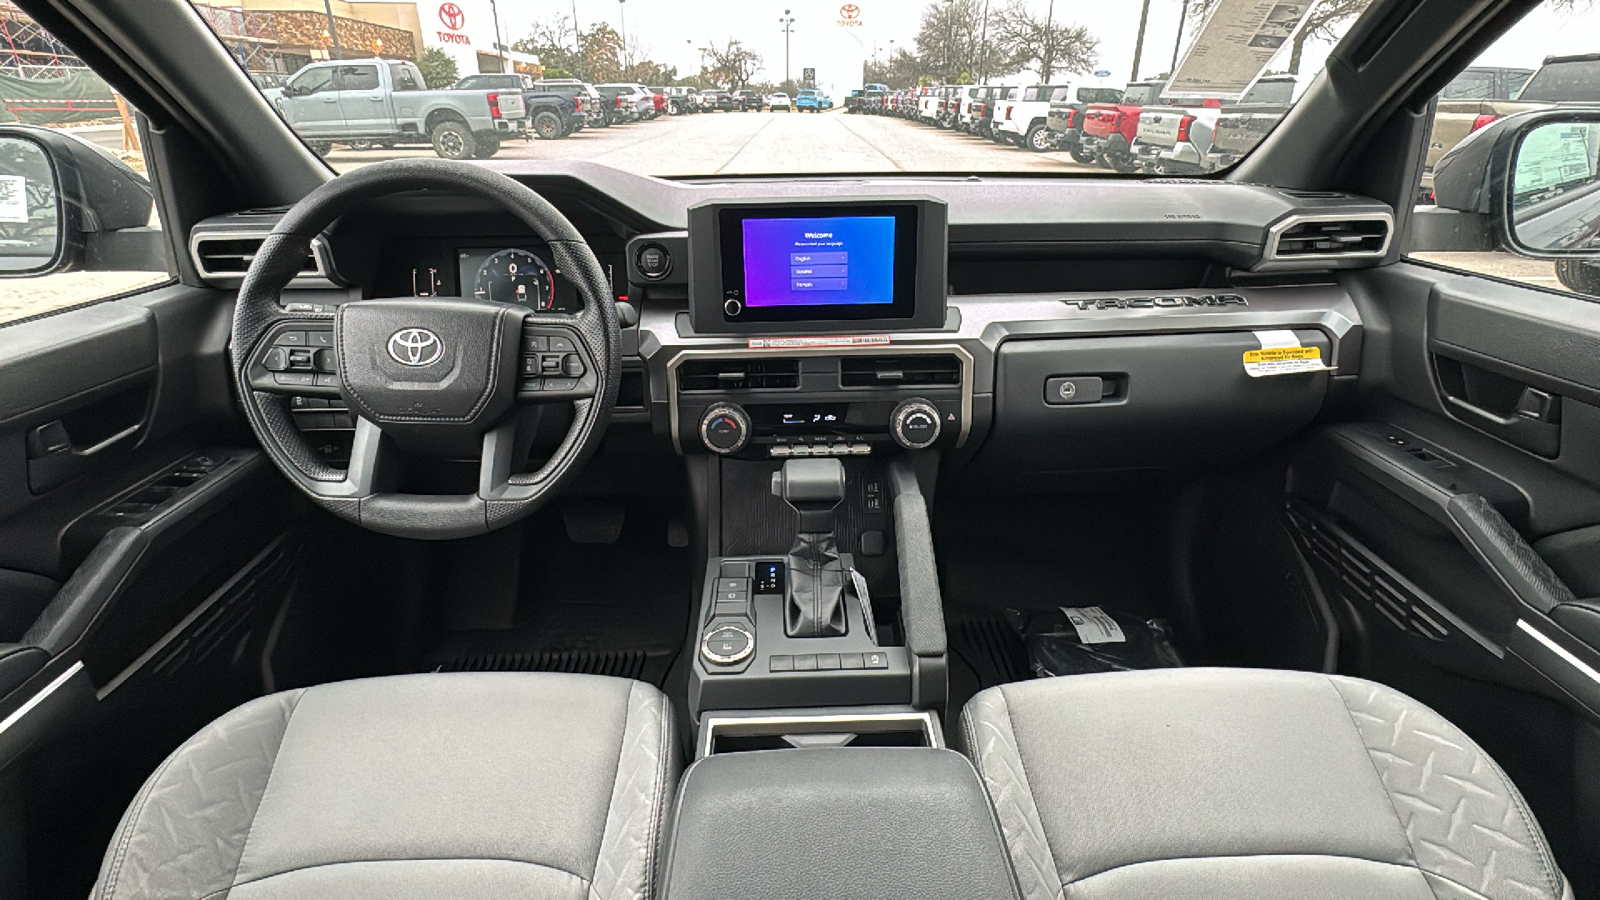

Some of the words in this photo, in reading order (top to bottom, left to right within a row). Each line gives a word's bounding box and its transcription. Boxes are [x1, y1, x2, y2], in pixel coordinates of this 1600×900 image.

[436, 31, 471, 45] TOYOTA
[509, 263, 518, 273] 0
[1059, 293, 1249, 311] TACOMA
